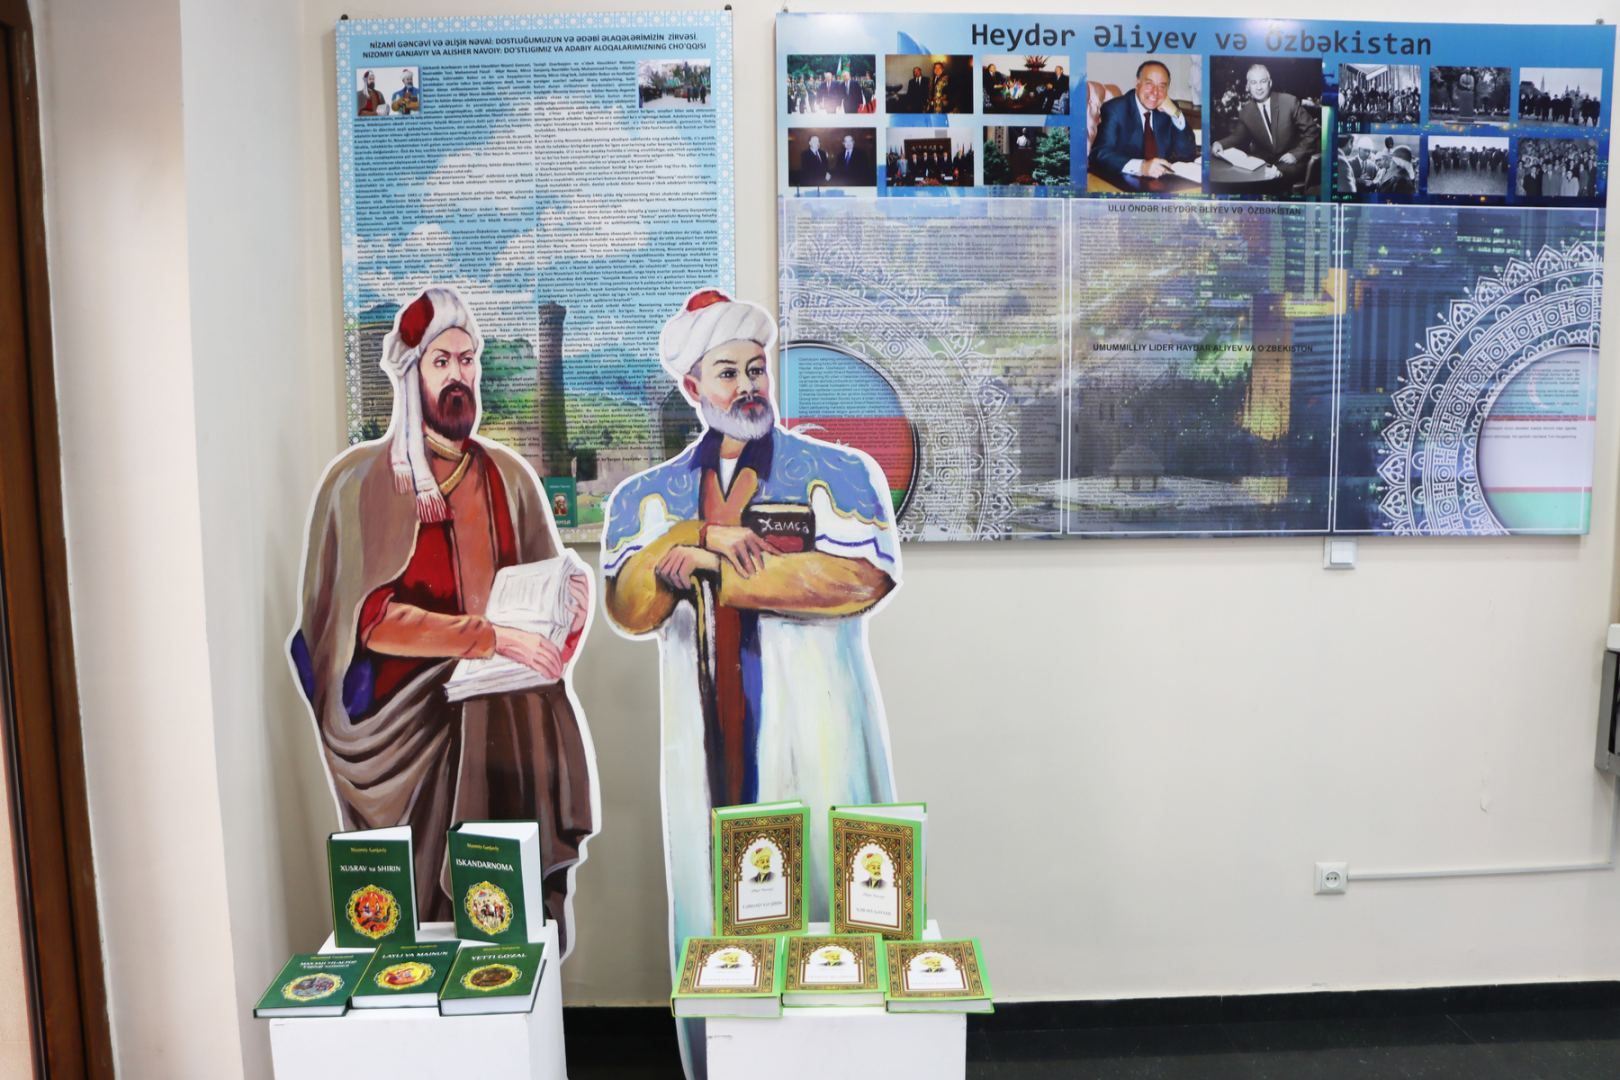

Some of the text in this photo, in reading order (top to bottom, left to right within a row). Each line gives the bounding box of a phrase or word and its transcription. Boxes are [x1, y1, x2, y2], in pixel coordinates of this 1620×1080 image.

[432, 39, 443, 47] VƏ
[563, 35, 575, 43] VƏ
[972, 23, 1431, 55] Heydər Əliyev və Özbəkistan
[362, 51, 394, 59] NIZOMIY
[431, 49, 442, 57] VA
[442, 48, 472, 56] ALISHER
[553, 45, 564, 53] VA
[564, 45, 592, 53] ADABIY
[593, 43, 667, 52] ALOQALARIMIZNING
[1108, 204, 1126, 212] ULU
[1127, 203, 1160, 213] ÖNDƏR
[1161, 204, 1198, 213] HEYDƏR
[1231, 206, 1243, 214] VƏ
[1149, 343, 1174, 352] LIDER
[1245, 344, 1255, 352] VA
[456, 858, 514, 872] ISKANDARNOMA
